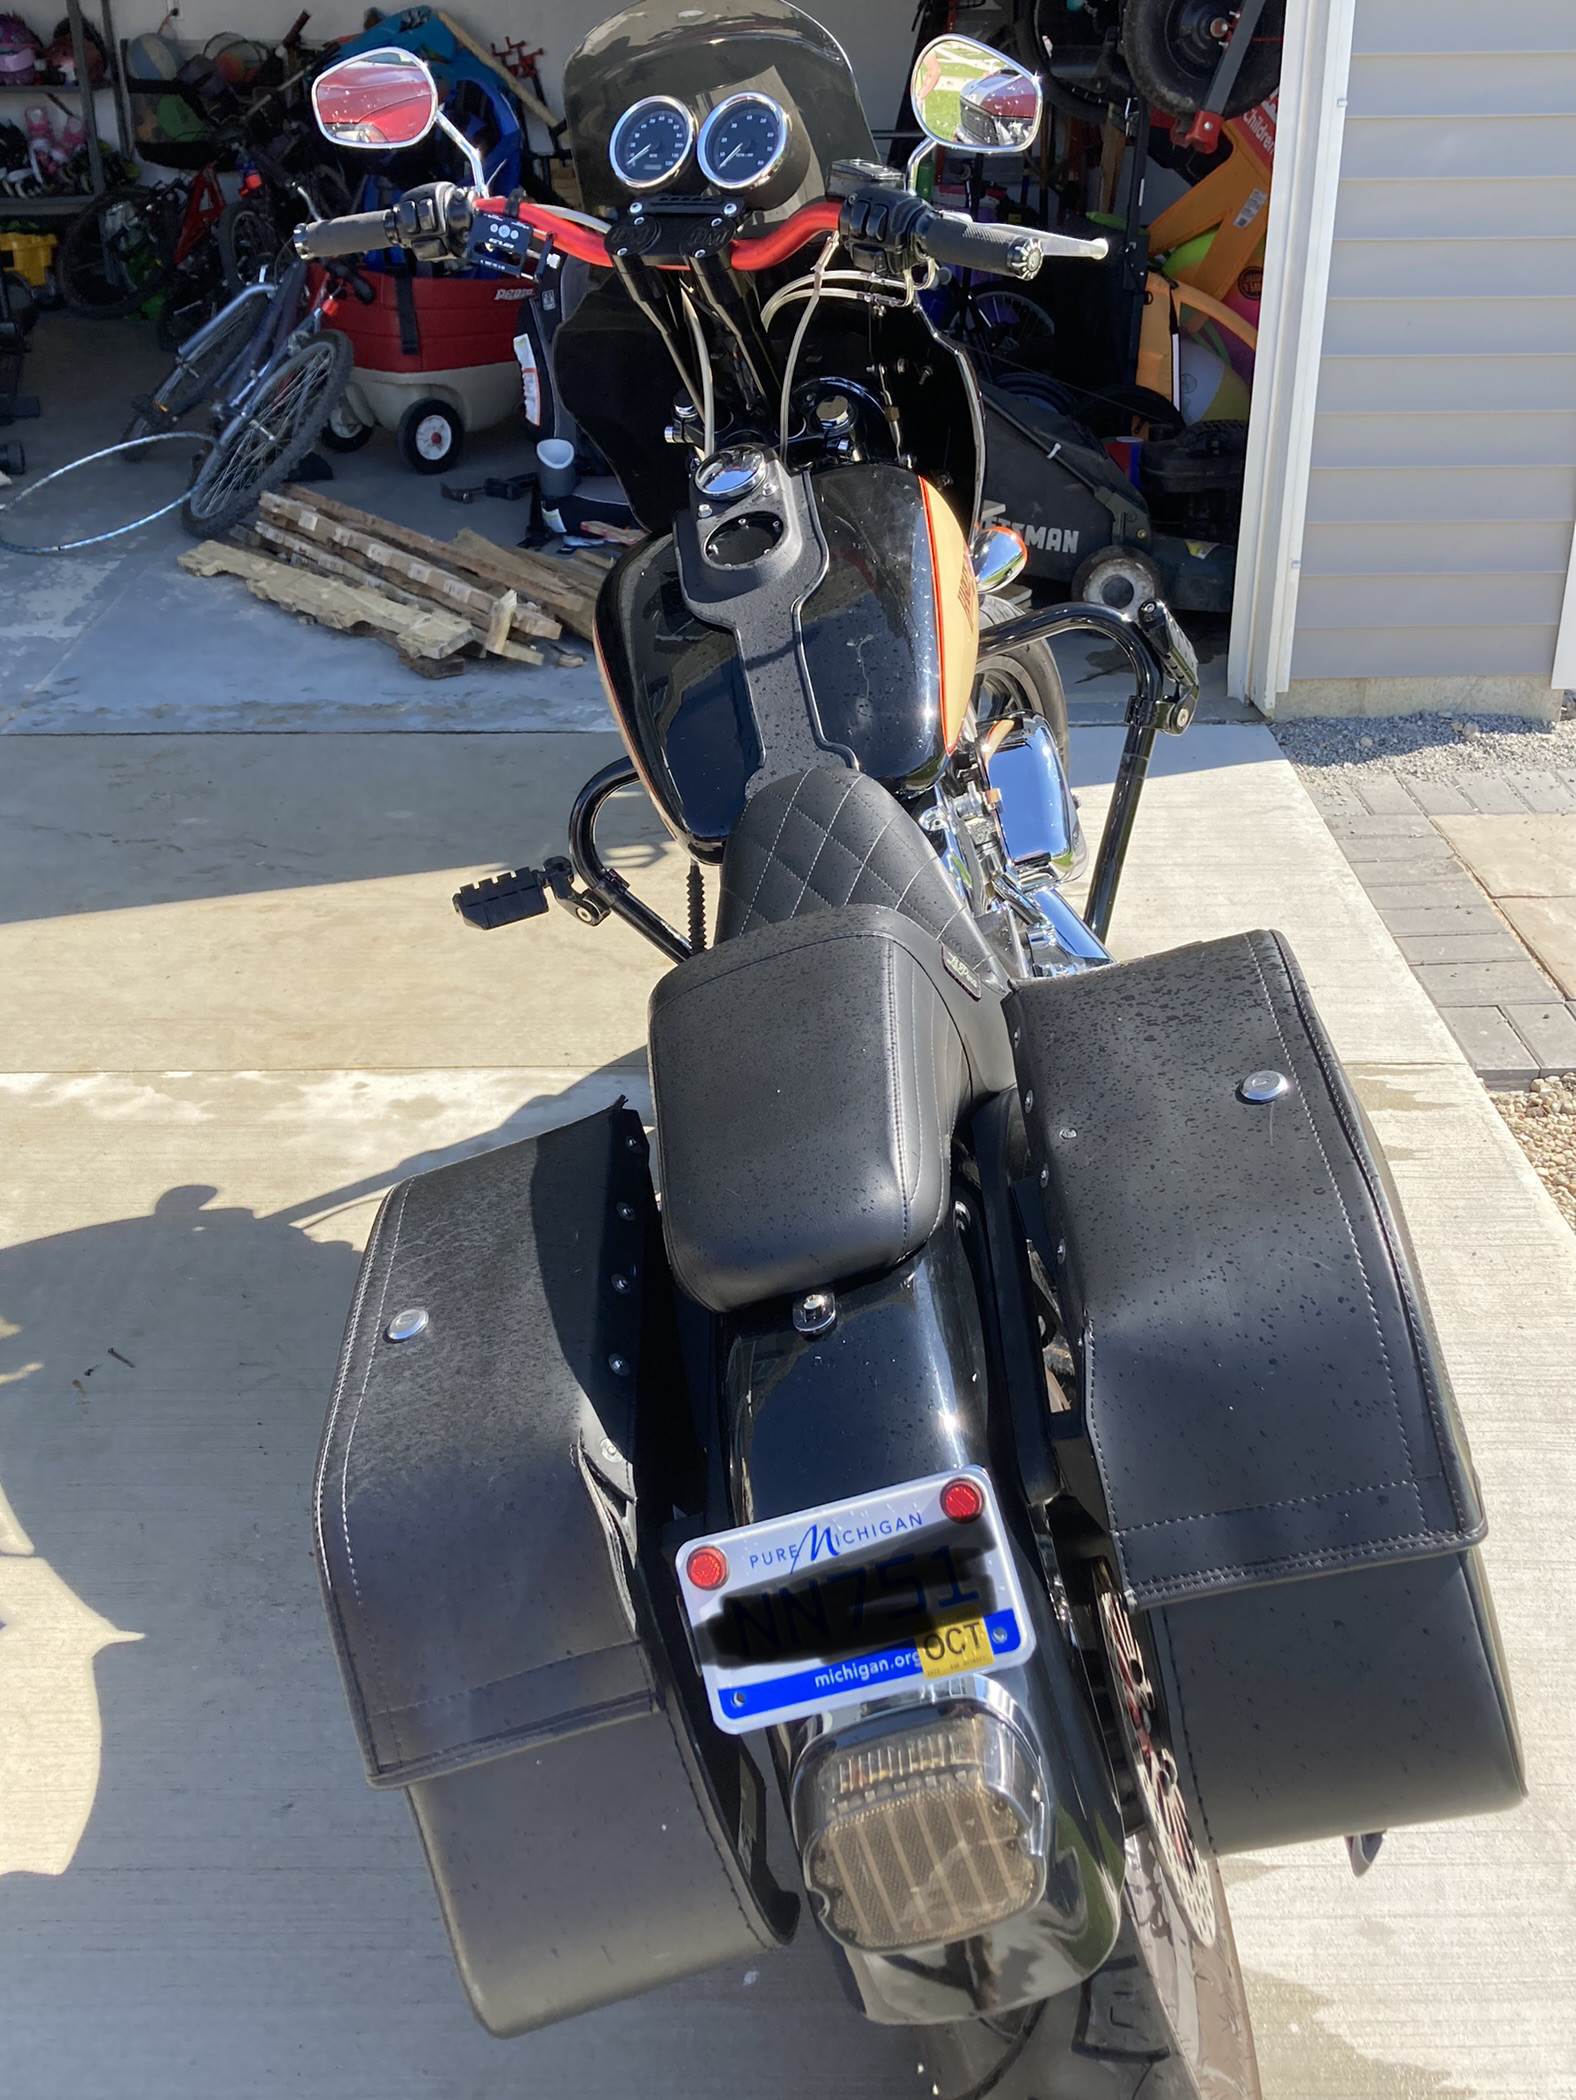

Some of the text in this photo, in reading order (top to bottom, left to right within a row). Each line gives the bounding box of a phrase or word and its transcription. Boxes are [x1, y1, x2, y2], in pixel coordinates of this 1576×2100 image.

[749, 1512, 923, 1575] PURE MICHIGAN
[923, 1620, 981, 1661] OCT
[814, 1650, 921, 1688] michigan.org
